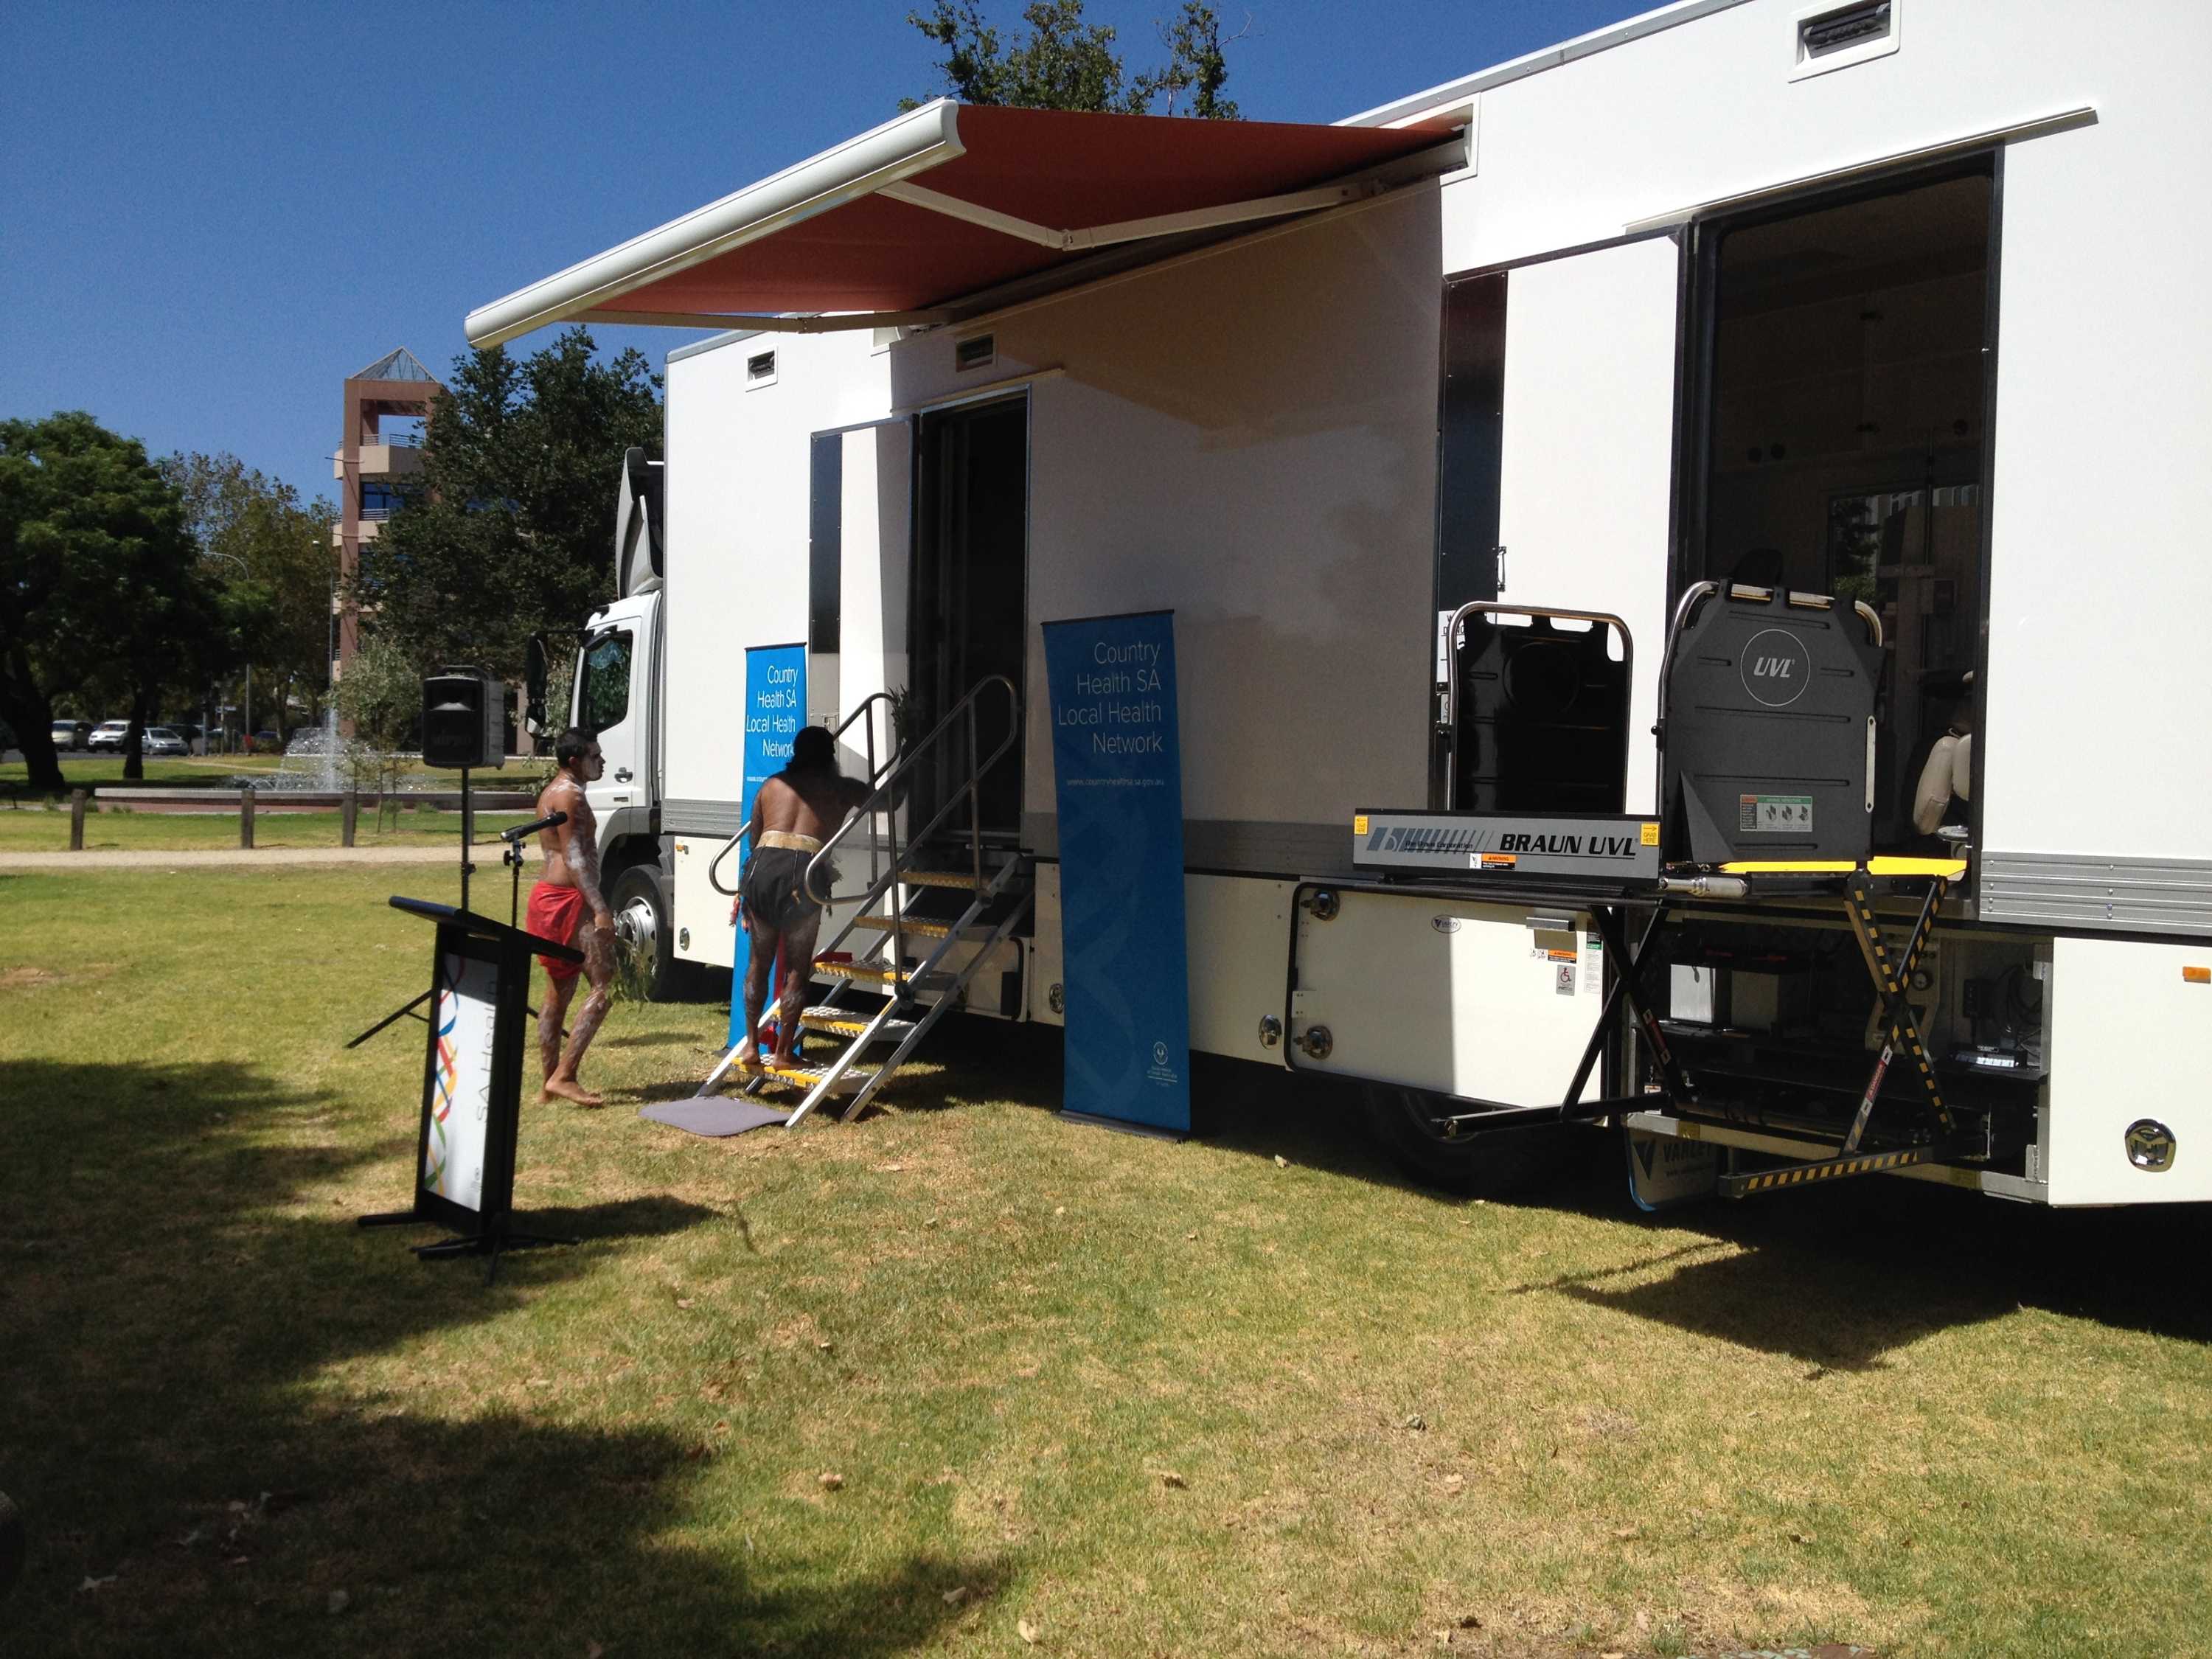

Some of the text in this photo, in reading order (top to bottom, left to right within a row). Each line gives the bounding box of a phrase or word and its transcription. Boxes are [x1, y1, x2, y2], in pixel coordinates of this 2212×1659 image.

[1094, 641, 1161, 666] Country
[768, 665, 799, 687] Country
[1753, 657, 1792, 678] UVL
[1077, 669, 1161, 695] Health SA
[757, 689, 797, 709] Health SA
[746, 714, 796, 733] Local Health
[1058, 700, 1161, 726] Local Health
[762, 738, 795, 757] Network
[1093, 731, 1163, 754] Network
[1499, 834, 1636, 856] BRAUN UVL
